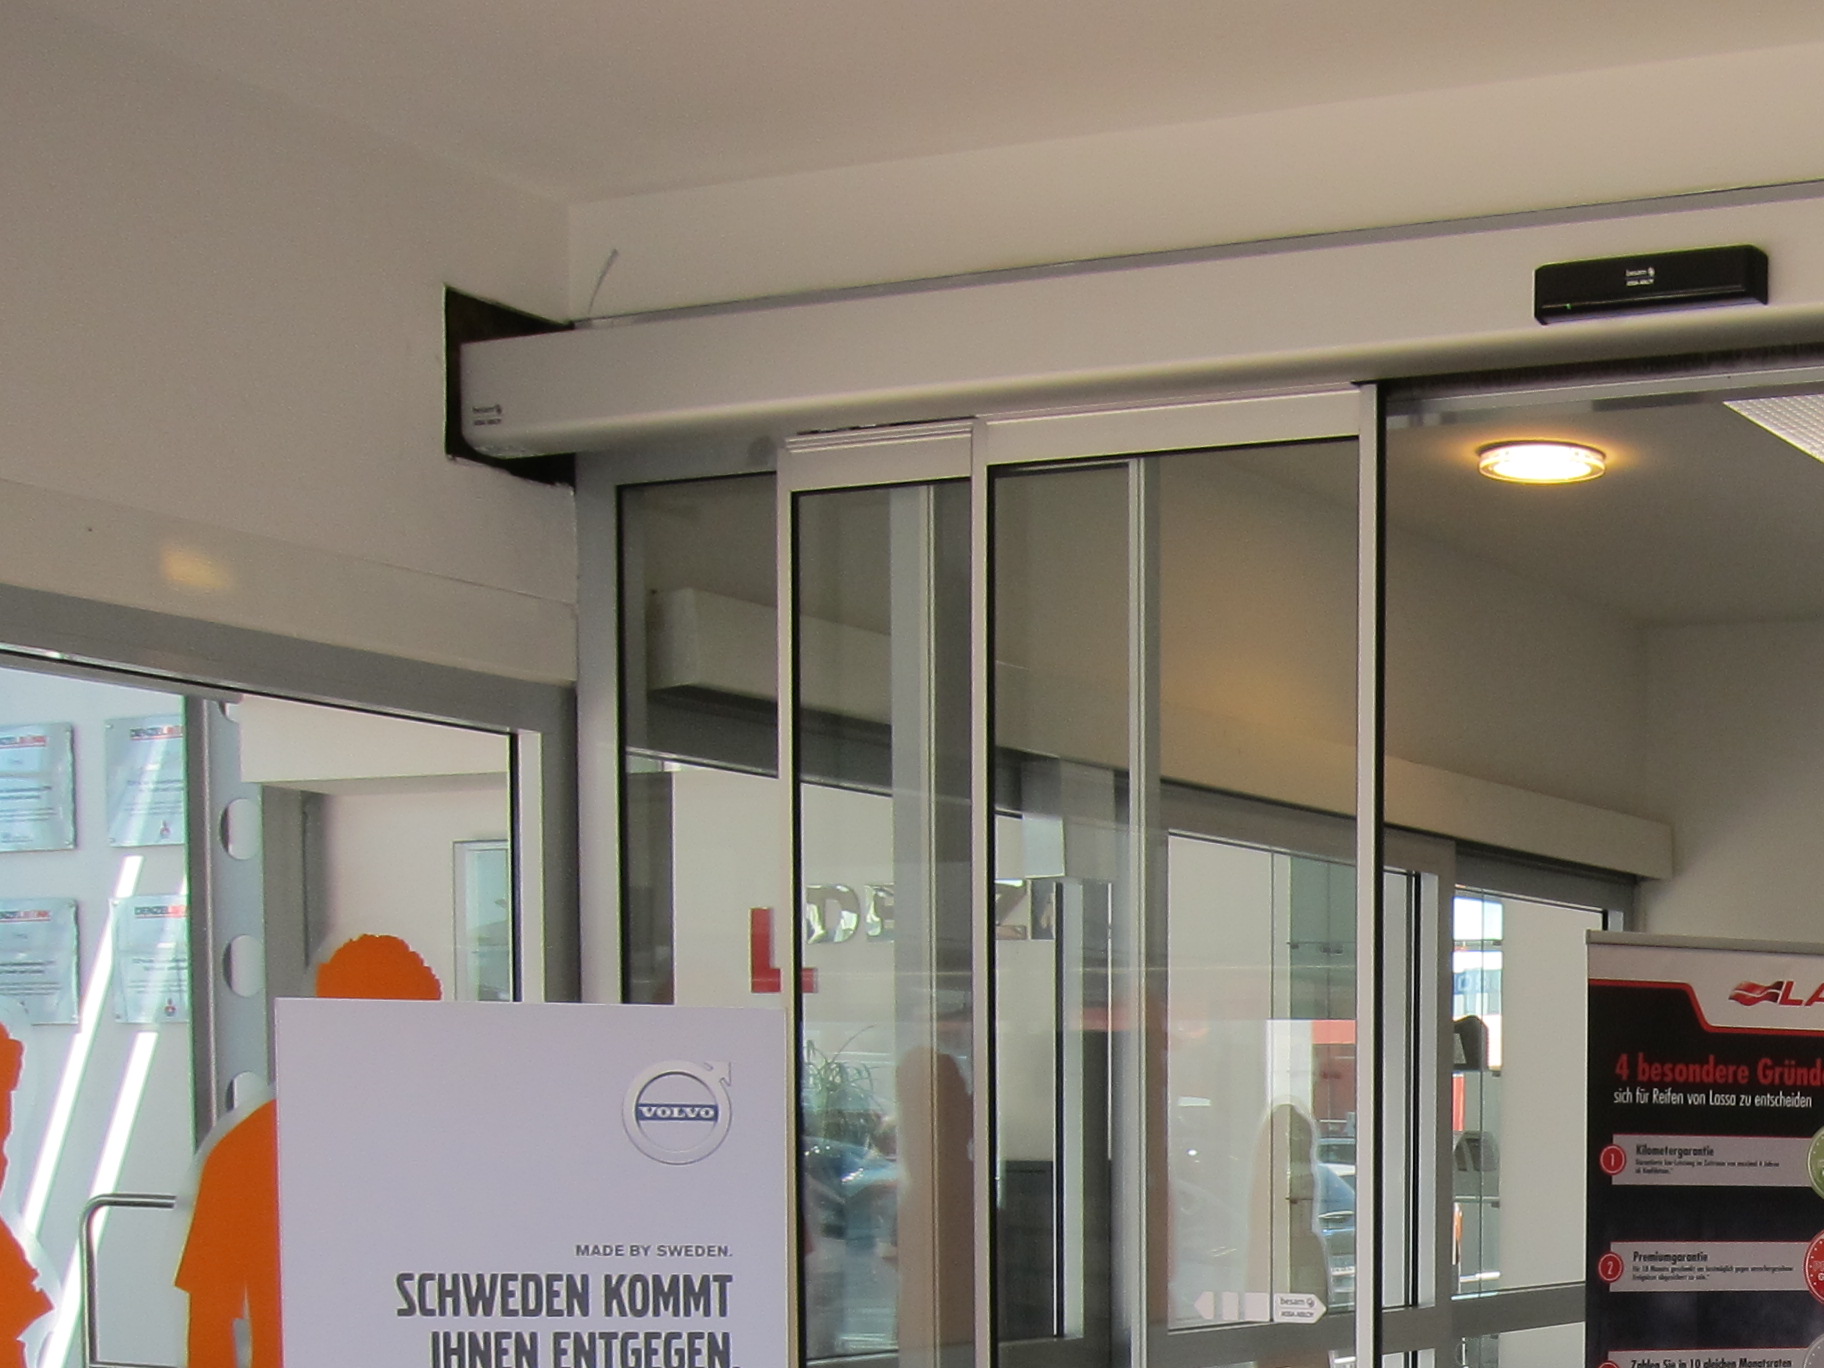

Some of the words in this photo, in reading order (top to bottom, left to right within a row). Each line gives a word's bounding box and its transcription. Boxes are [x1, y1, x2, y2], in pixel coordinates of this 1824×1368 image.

[1614, 1053, 1629, 1081] 4
[1637, 1052, 1749, 1084] besondere
[1614, 1087, 1632, 1103] sich
[1636, 1088, 1649, 1103] für
[1653, 1088, 1683, 1104] Reifen
[1687, 1094, 1705, 1105] von
[1710, 1090, 1736, 1106] Lassa
[1740, 1095, 1751, 1106] zu
[1755, 1092, 1812, 1108] entscheiden
[641, 1105, 715, 1119] VOLVO
[1635, 1144, 1714, 1159] Kilometergarantie
[576, 1245, 624, 1256] MADE
[630, 1245, 651, 1256] BY
[1632, 1250, 1709, 1265] Premiumgarantie
[396, 1273, 589, 1317] SCHWEDEN
[604, 1274, 733, 1317] KOMMT
[1679, 1360, 1686, 1368] in
[1691, 1359, 1700, 1368] 10
[1739, 1358, 1791, 1368] Monatsraten
